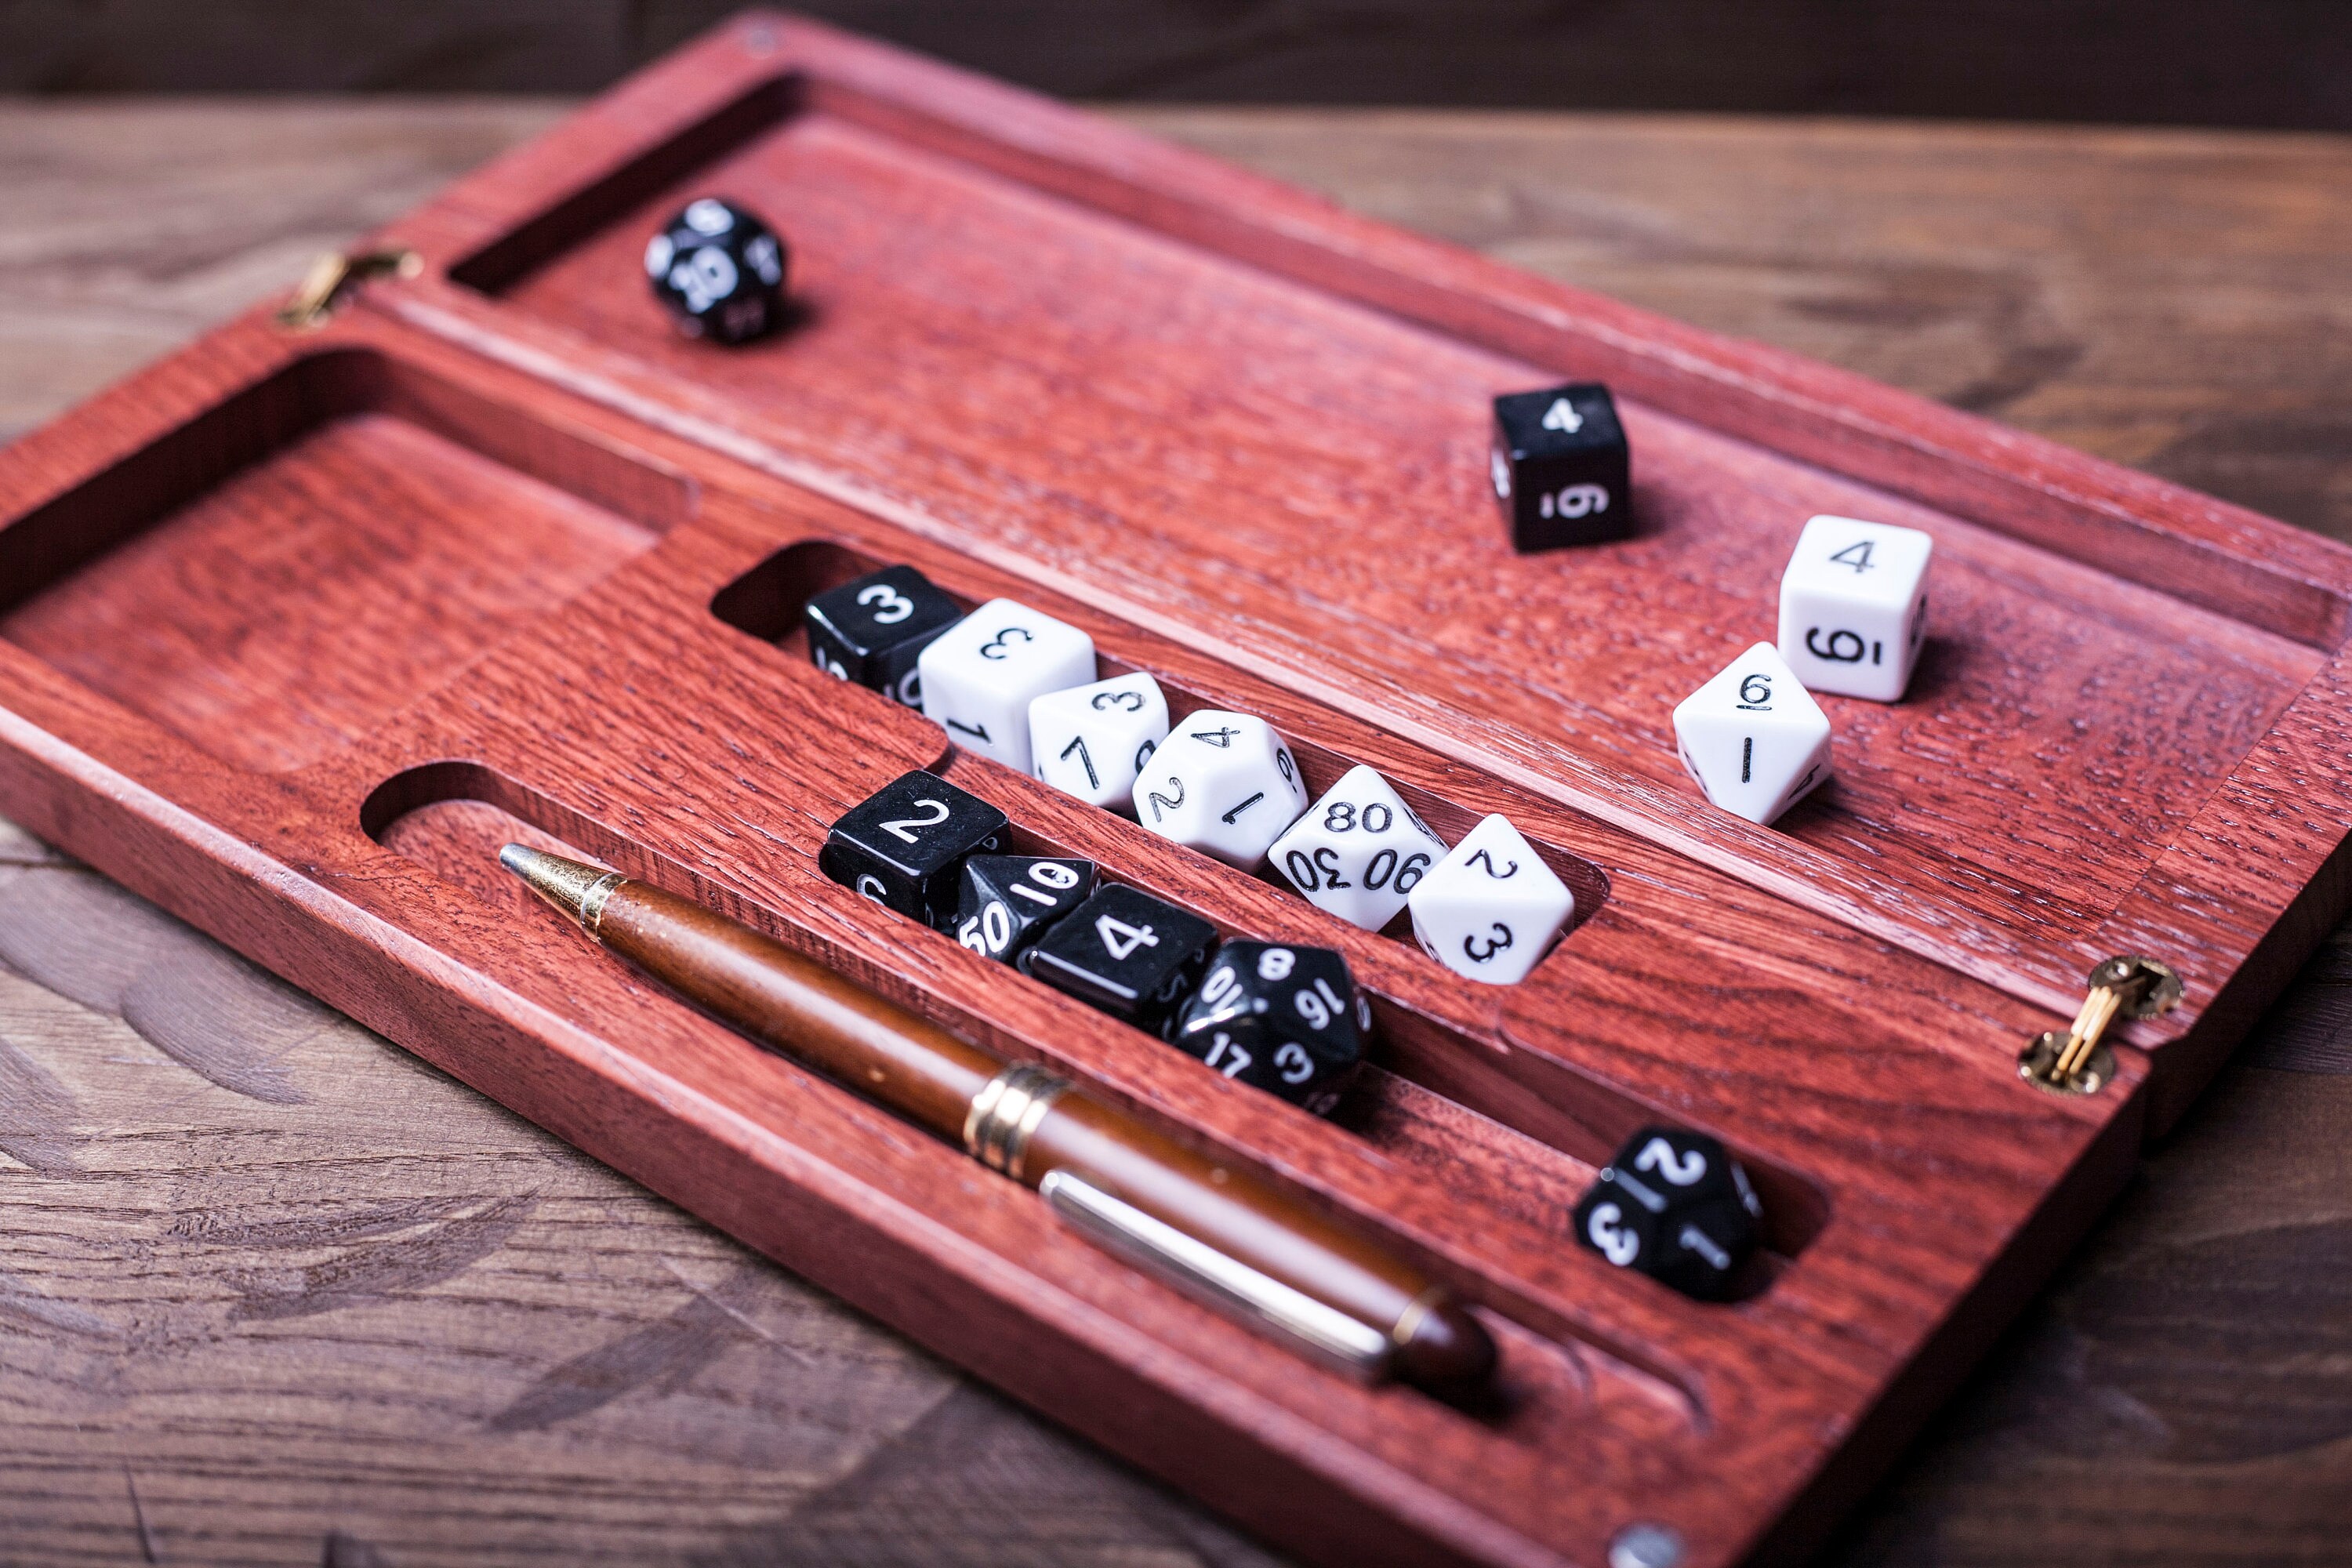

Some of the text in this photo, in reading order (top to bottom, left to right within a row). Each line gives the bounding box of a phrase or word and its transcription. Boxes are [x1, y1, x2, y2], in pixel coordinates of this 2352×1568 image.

[1541, 397, 1584, 434] 4
[1830, 541, 1875, 573] 4
[857, 584, 914, 624] 3
[979, 628, 1033, 659] 3
[1092, 691, 1146, 712] 3
[1736, 673, 1773, 710] 6
[946, 717, 994, 746] 1
[1190, 727, 1240, 748] 4
[1060, 735, 1100, 790] 7
[1741, 736, 1752, 784] 1
[878, 799, 950, 844] 2
[1149, 777, 1185, 823] 2
[1221, 784, 1264, 825] 1
[1323, 801, 1393, 833] 80
[1009, 862, 1080, 906] 10
[1286, 848, 1352, 892] 30
[1464, 848, 1518, 879] 2
[959, 901, 1011, 957] 50
[1094, 913, 1160, 960] 4
[1463, 922, 1513, 964] 3
[1257, 947, 1296, 981] 8
[1203, 1031, 1253, 1080] 17
[1273, 1040, 1315, 1084] 3
[1634, 1137, 1708, 1186] 2
[1588, 1201, 1640, 1267] 3
[1679, 1222, 1731, 1271] 1
